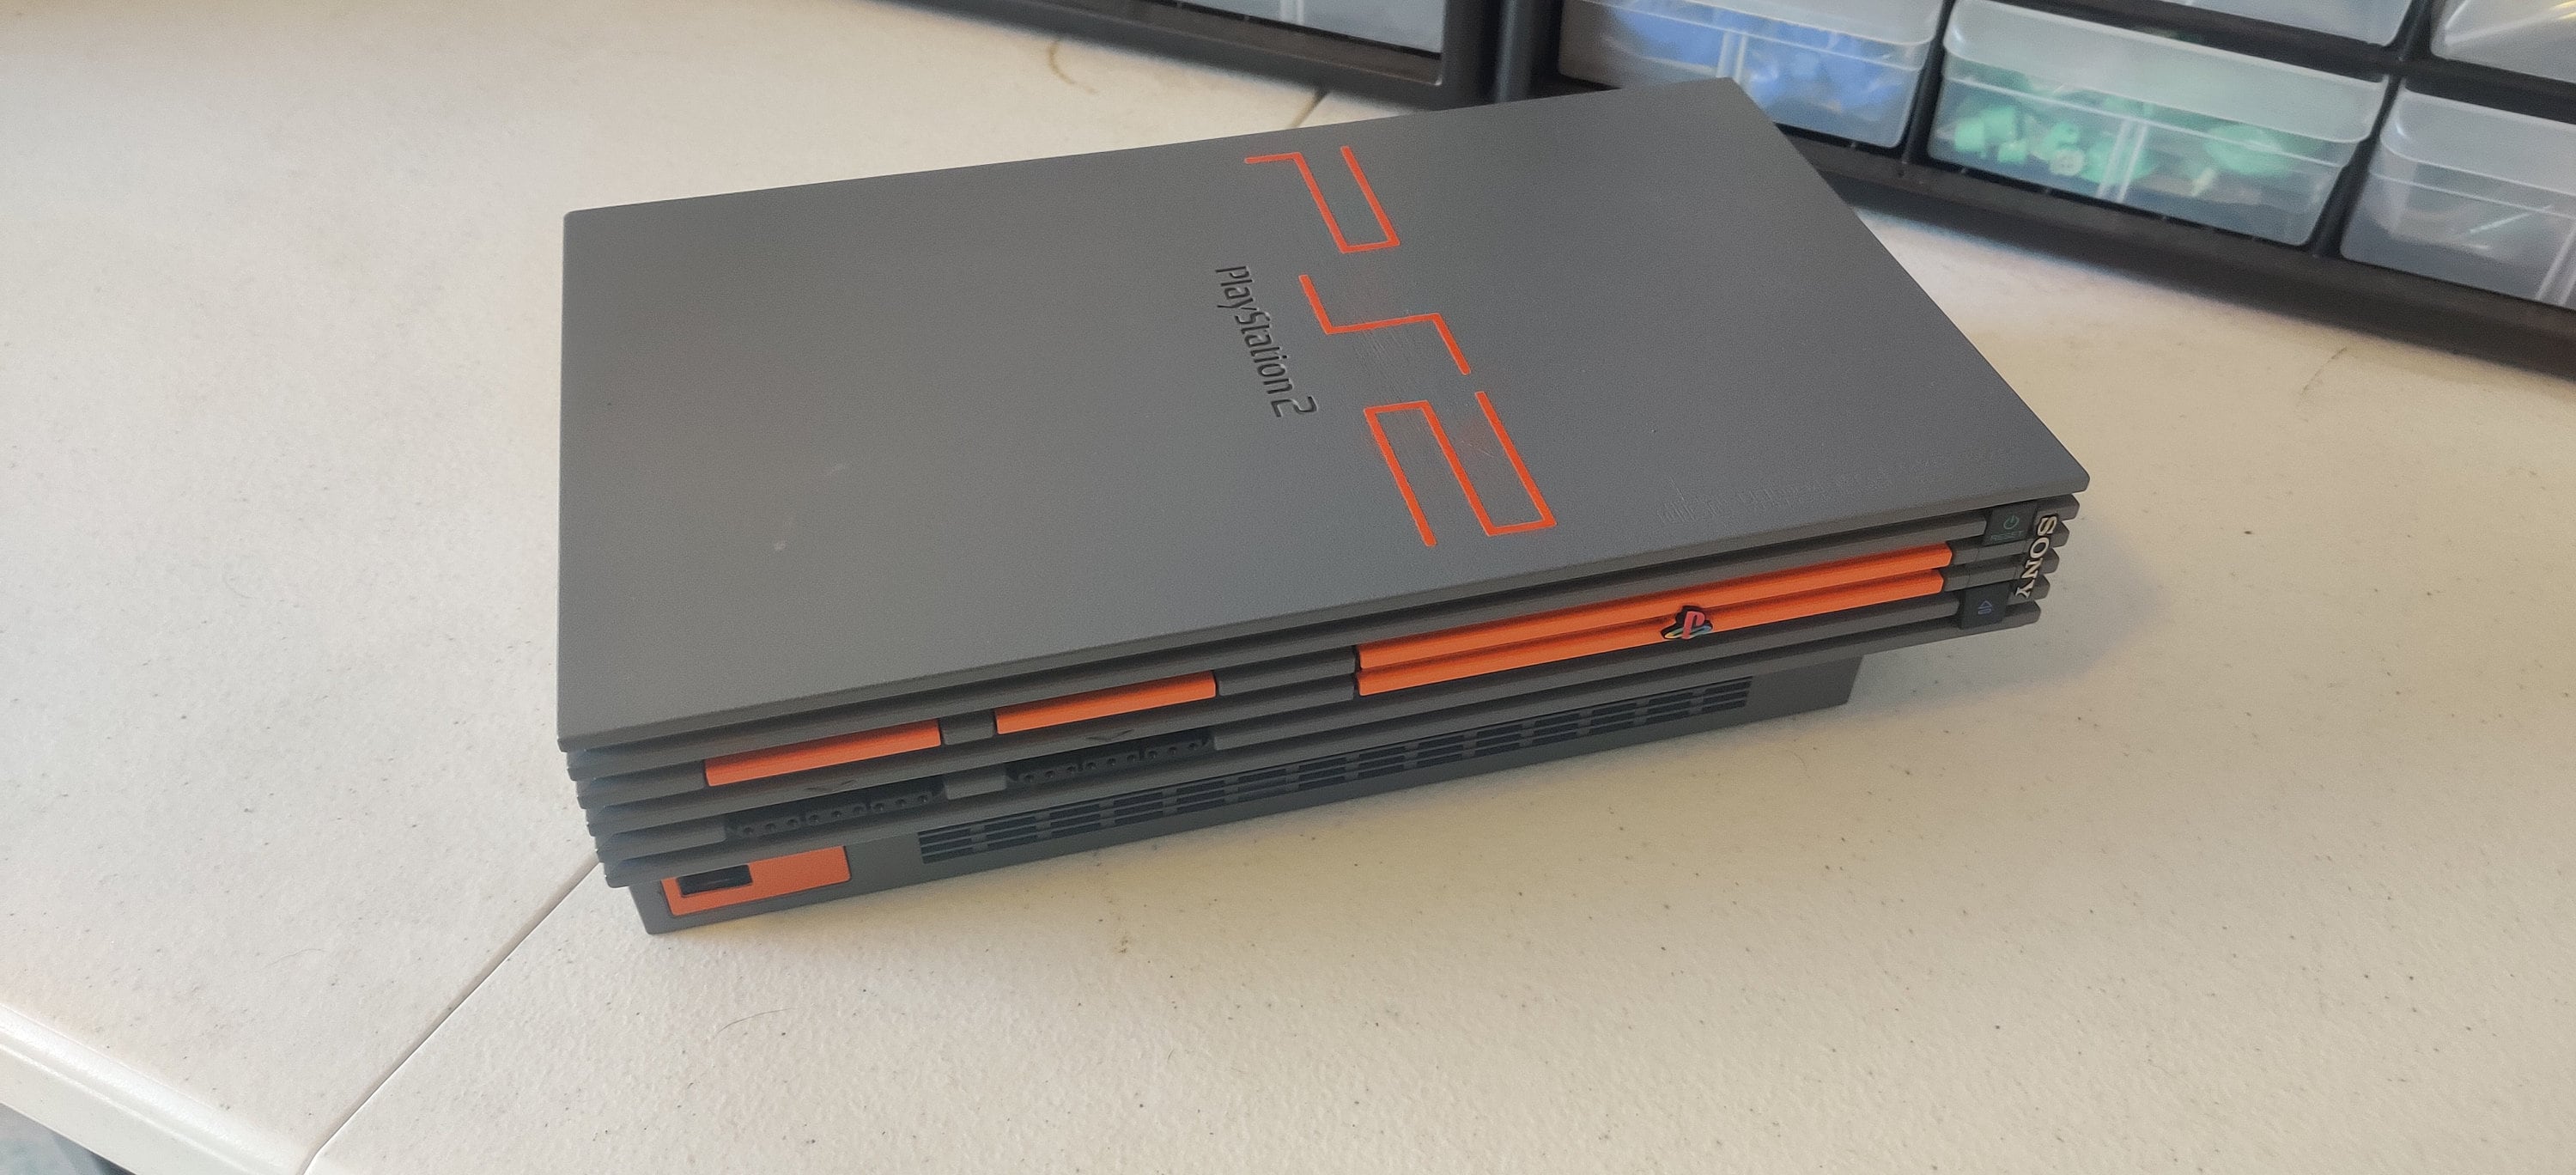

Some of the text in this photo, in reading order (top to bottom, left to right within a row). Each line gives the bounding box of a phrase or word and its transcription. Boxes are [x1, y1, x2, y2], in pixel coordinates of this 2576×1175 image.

[1215, 266, 1318, 418] PlayStation 2
[2014, 515, 2057, 600] SONY
